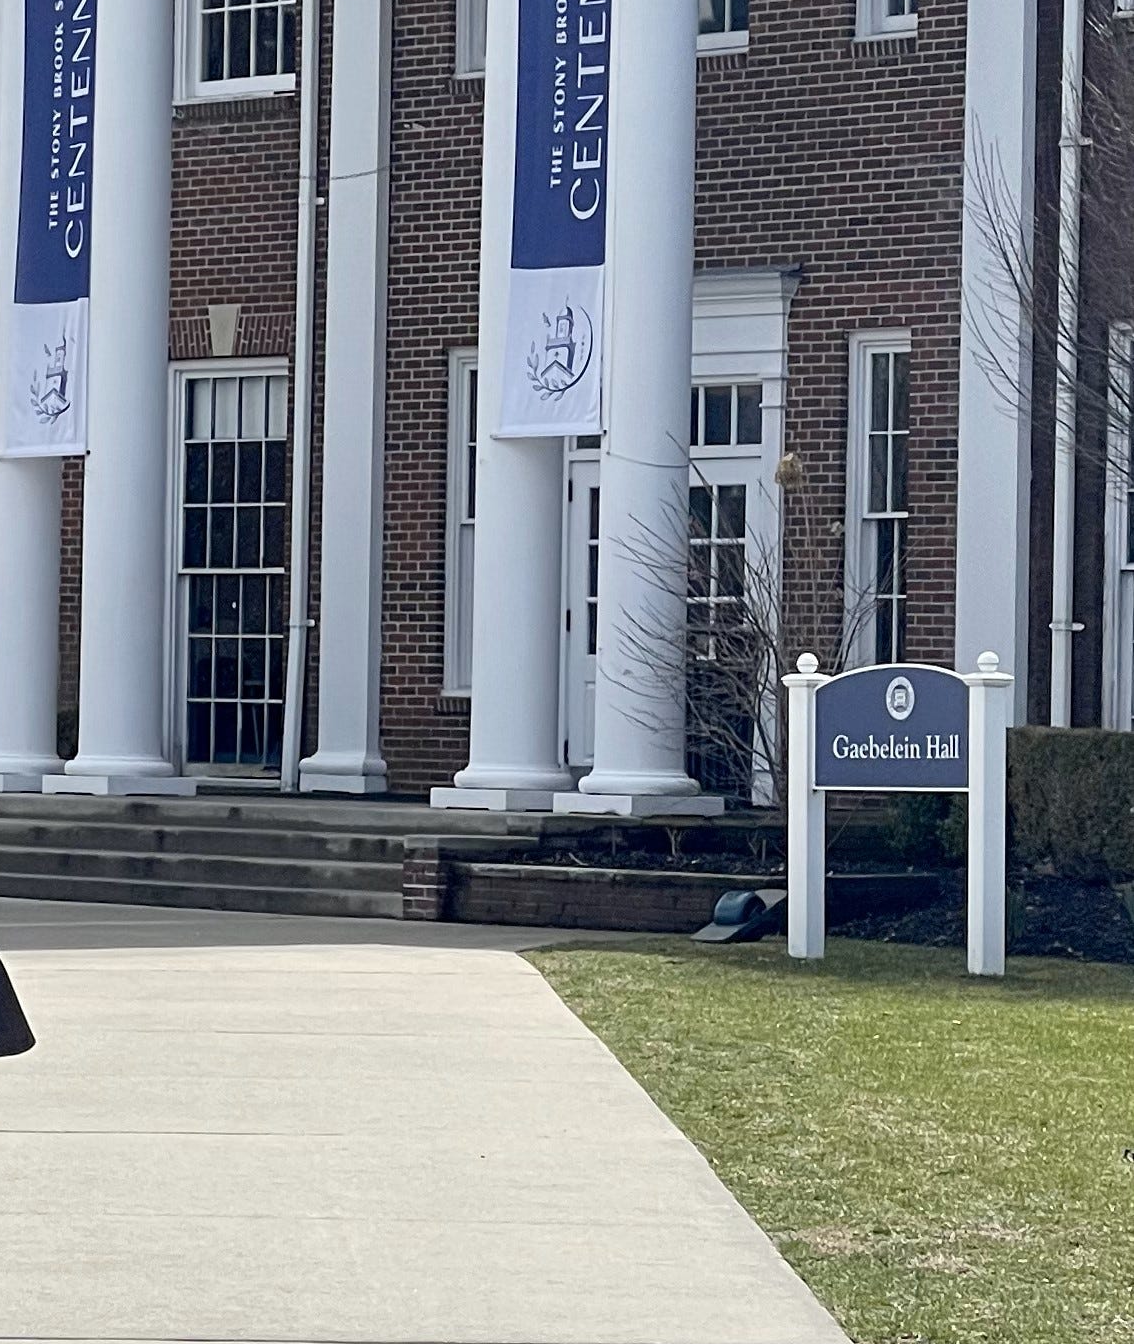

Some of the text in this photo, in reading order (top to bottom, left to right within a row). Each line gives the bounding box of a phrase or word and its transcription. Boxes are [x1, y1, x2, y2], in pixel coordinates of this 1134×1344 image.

[53, 22, 64, 98] BROOK
[553, 56, 567, 134] STONY
[50, 109, 62, 179] STONY
[550, 145, 564, 188] THE
[48, 190, 59, 230] THE
[832, 734, 960, 759] Gaebelein Hall
